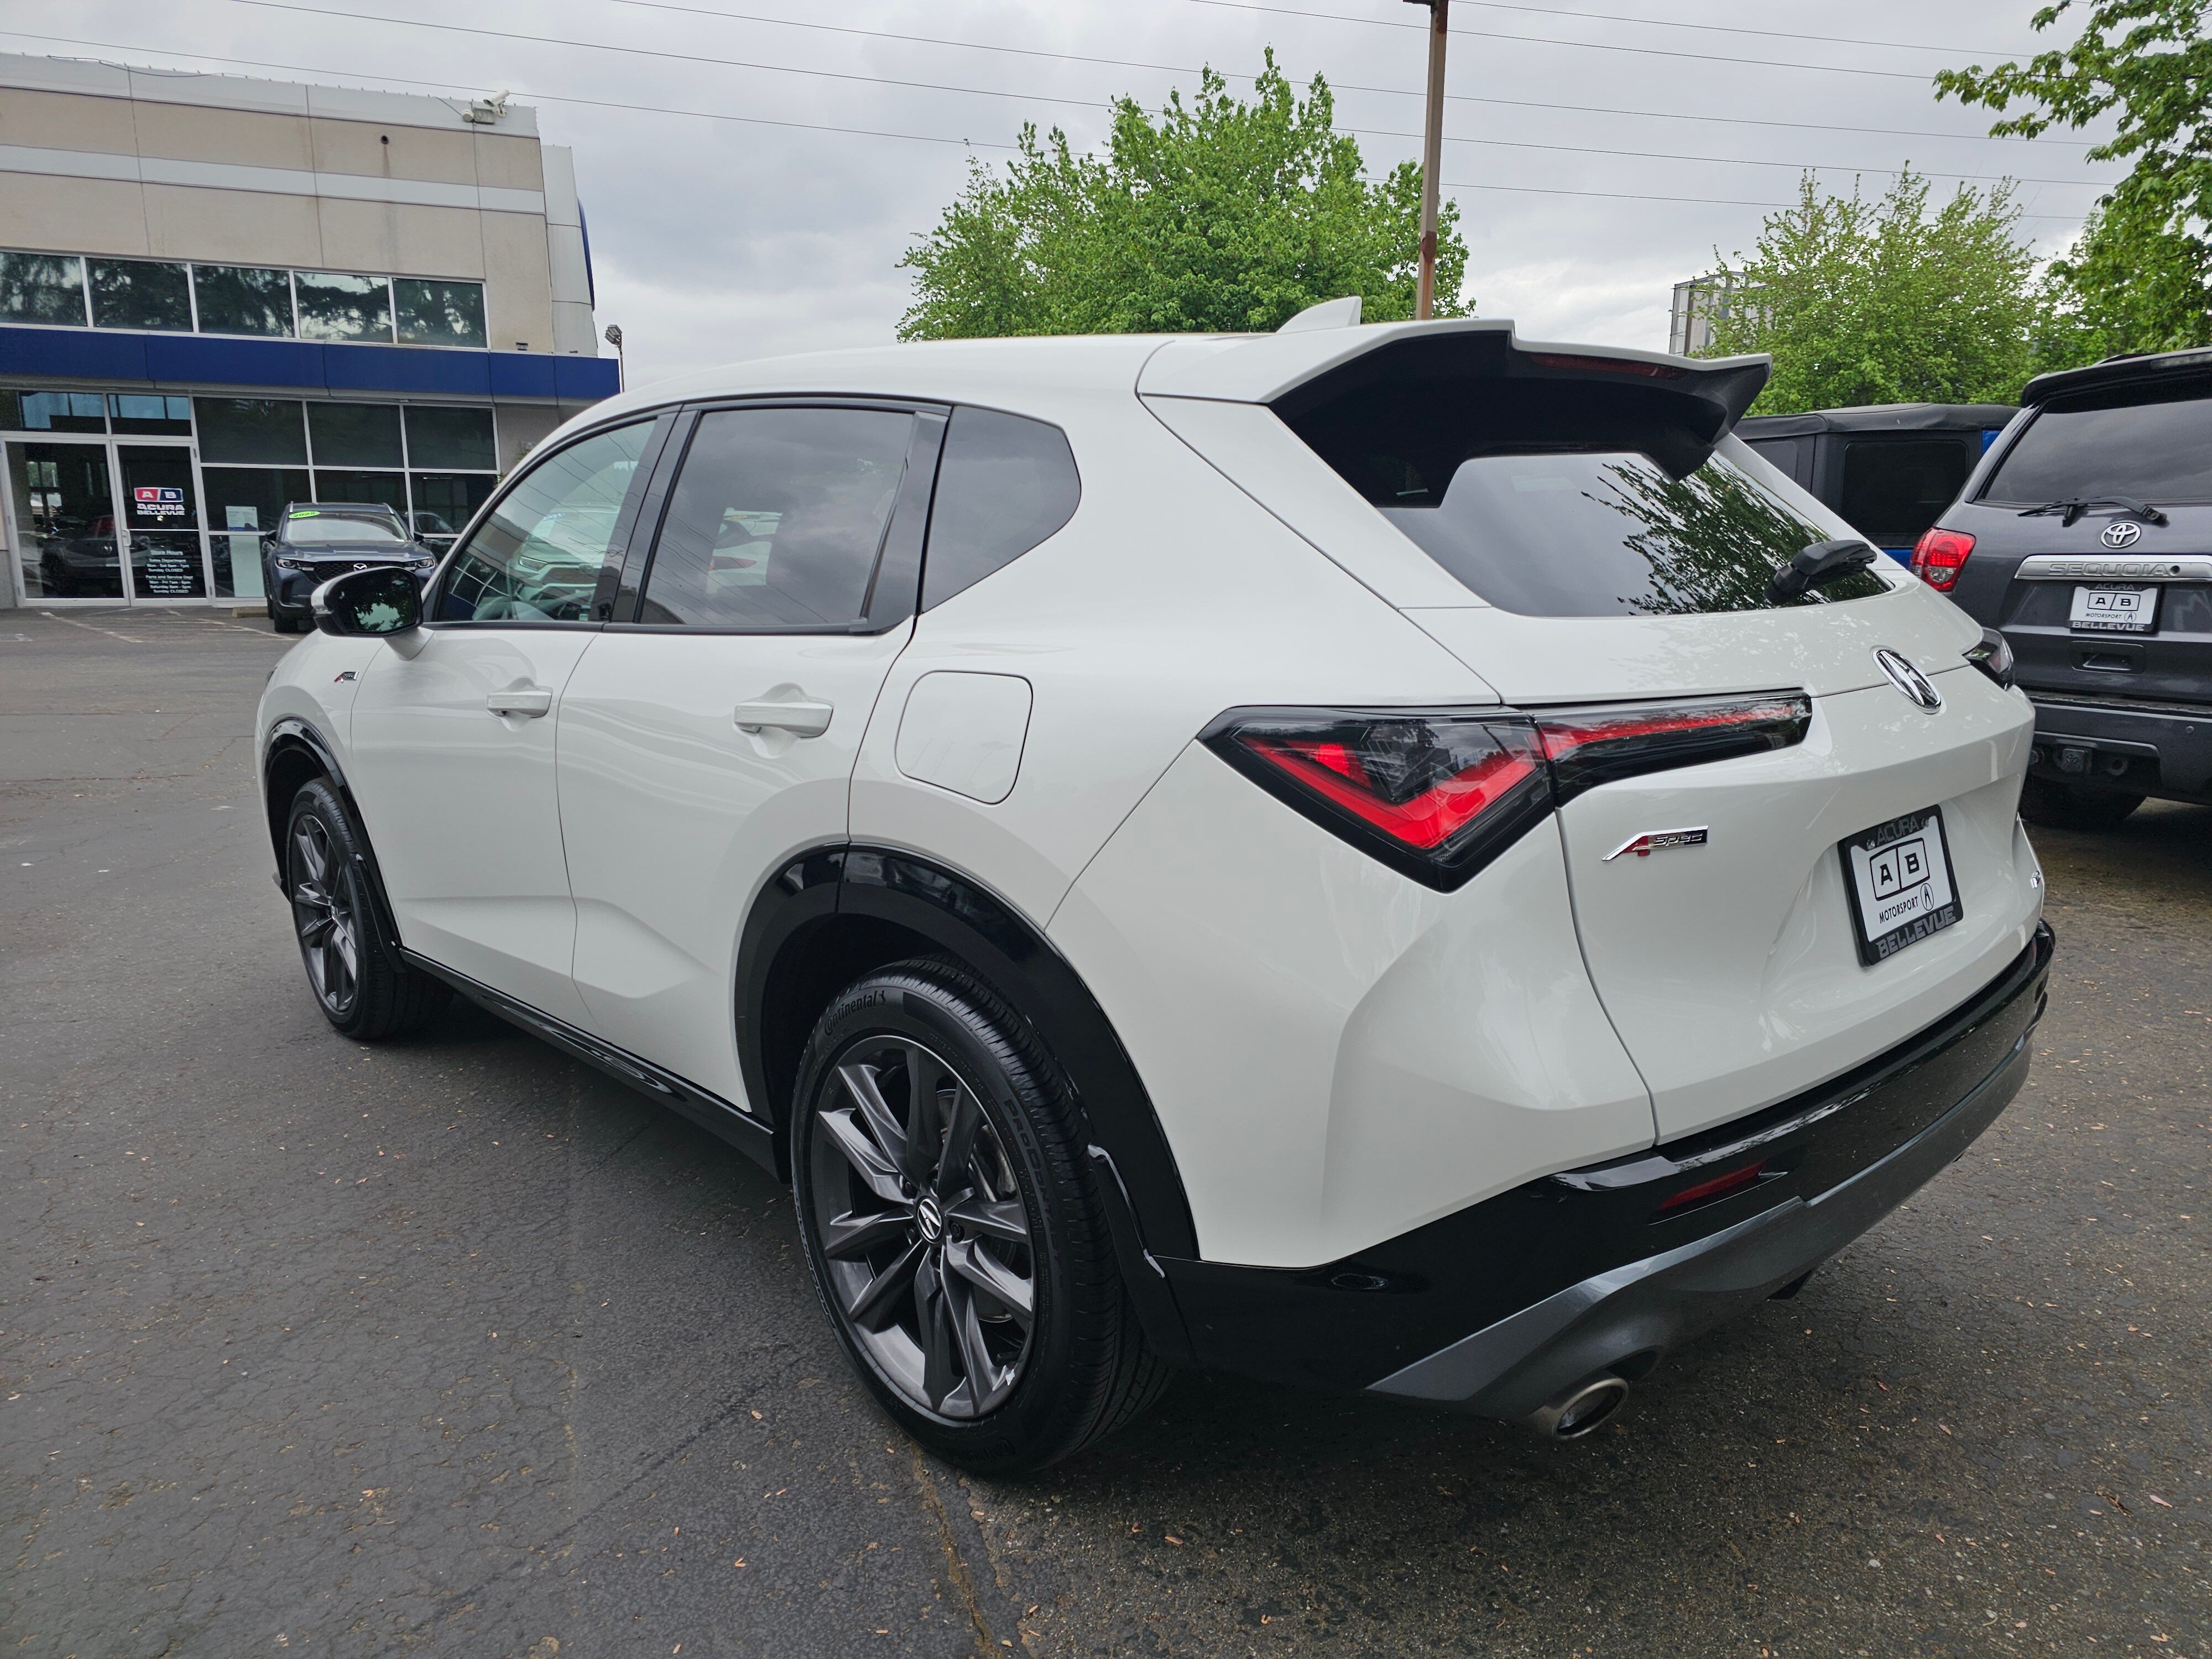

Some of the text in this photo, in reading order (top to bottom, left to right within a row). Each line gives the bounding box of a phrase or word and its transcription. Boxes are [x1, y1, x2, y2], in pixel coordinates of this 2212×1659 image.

[2048, 562, 2170, 577] SEQUOIA
[2094, 583, 2135, 591] ACURA
[2095, 597, 2131, 606] A B
[2072, 621, 2145, 632] BELLEVUE
[1876, 814, 1919, 846] ACURA
[1879, 852, 1920, 886] A B
[1879, 895, 1918, 924] MOTORSPORT
[1875, 906, 1957, 959] BELLEVUE
[823, 990, 878, 1037] Continental
